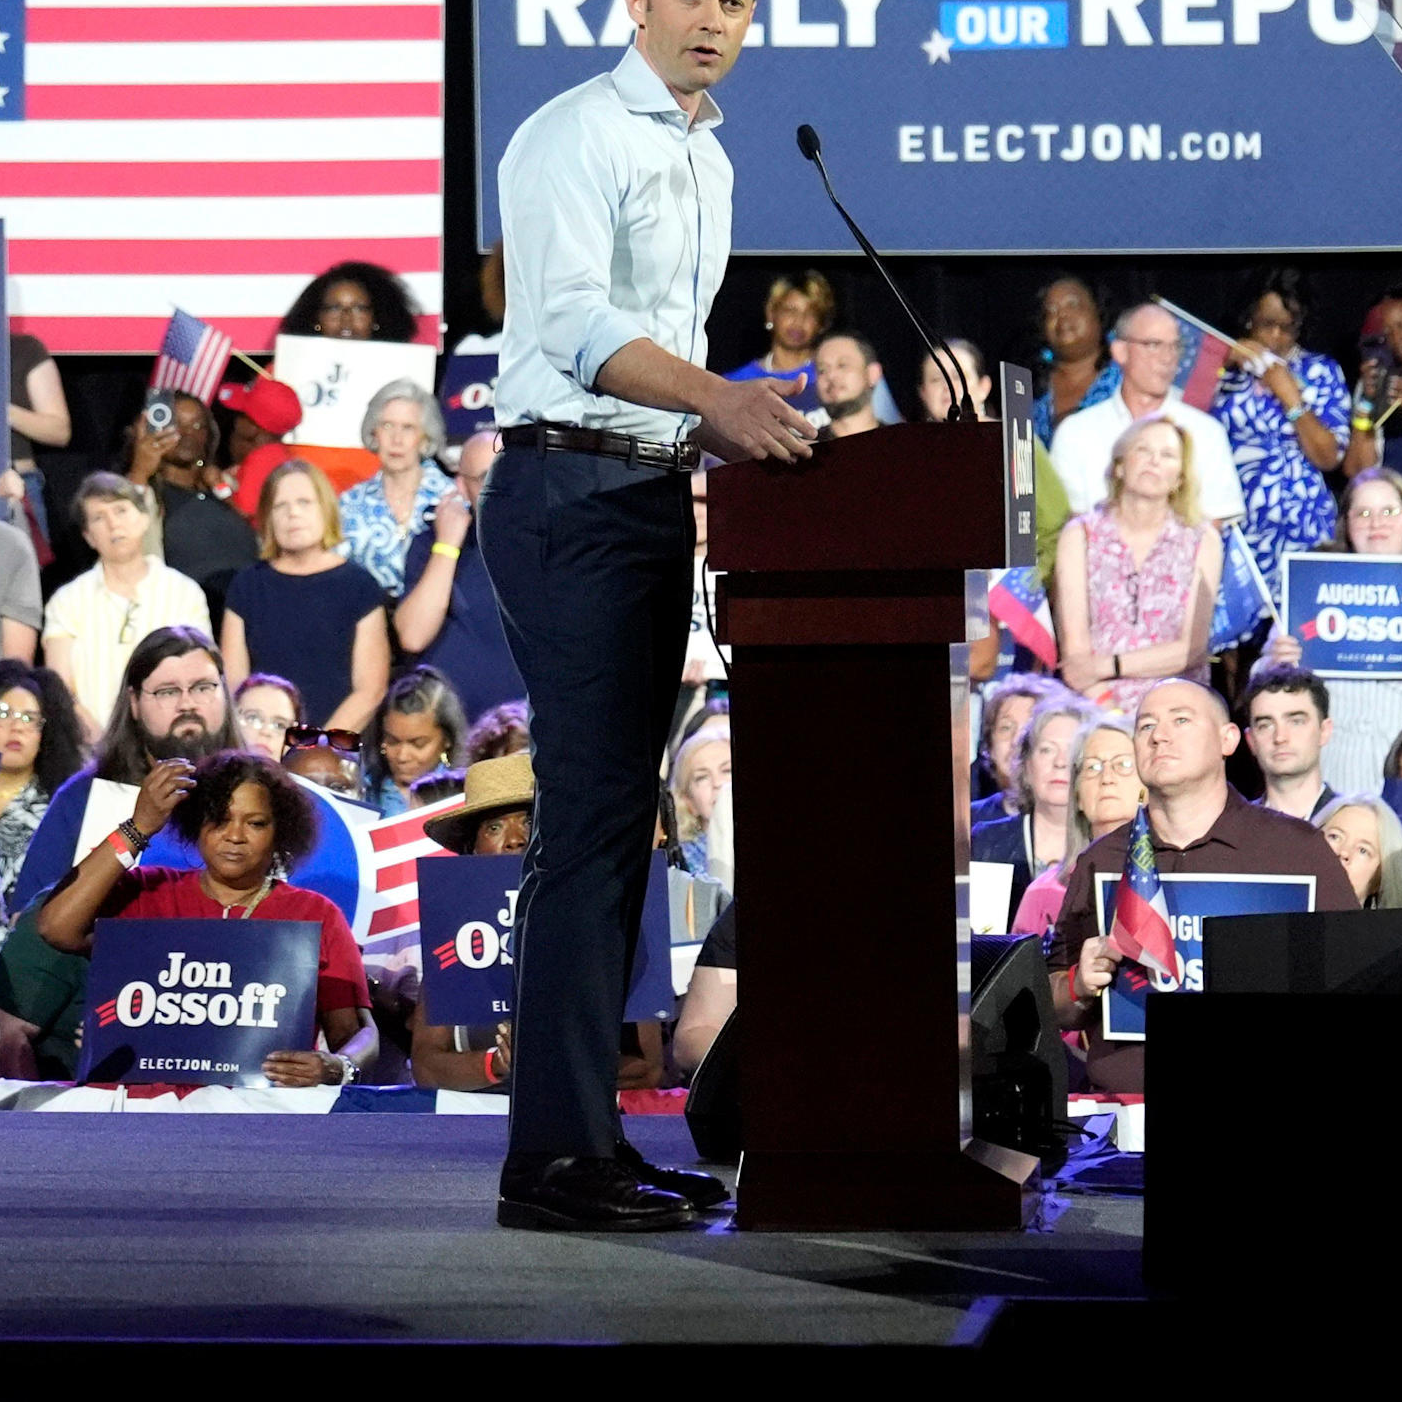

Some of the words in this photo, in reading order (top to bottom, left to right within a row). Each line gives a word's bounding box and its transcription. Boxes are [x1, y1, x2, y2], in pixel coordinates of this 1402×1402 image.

[955, 5, 1049, 45] OUR
[898, 122, 1263, 163] ELECTJON.COM
[1316, 582, 1399, 607] AUGUSTA
[157, 951, 232, 989] Jon
[115, 980, 287, 1028] Ossoff
[138, 1057, 240, 1073] ELECTJON.COM
